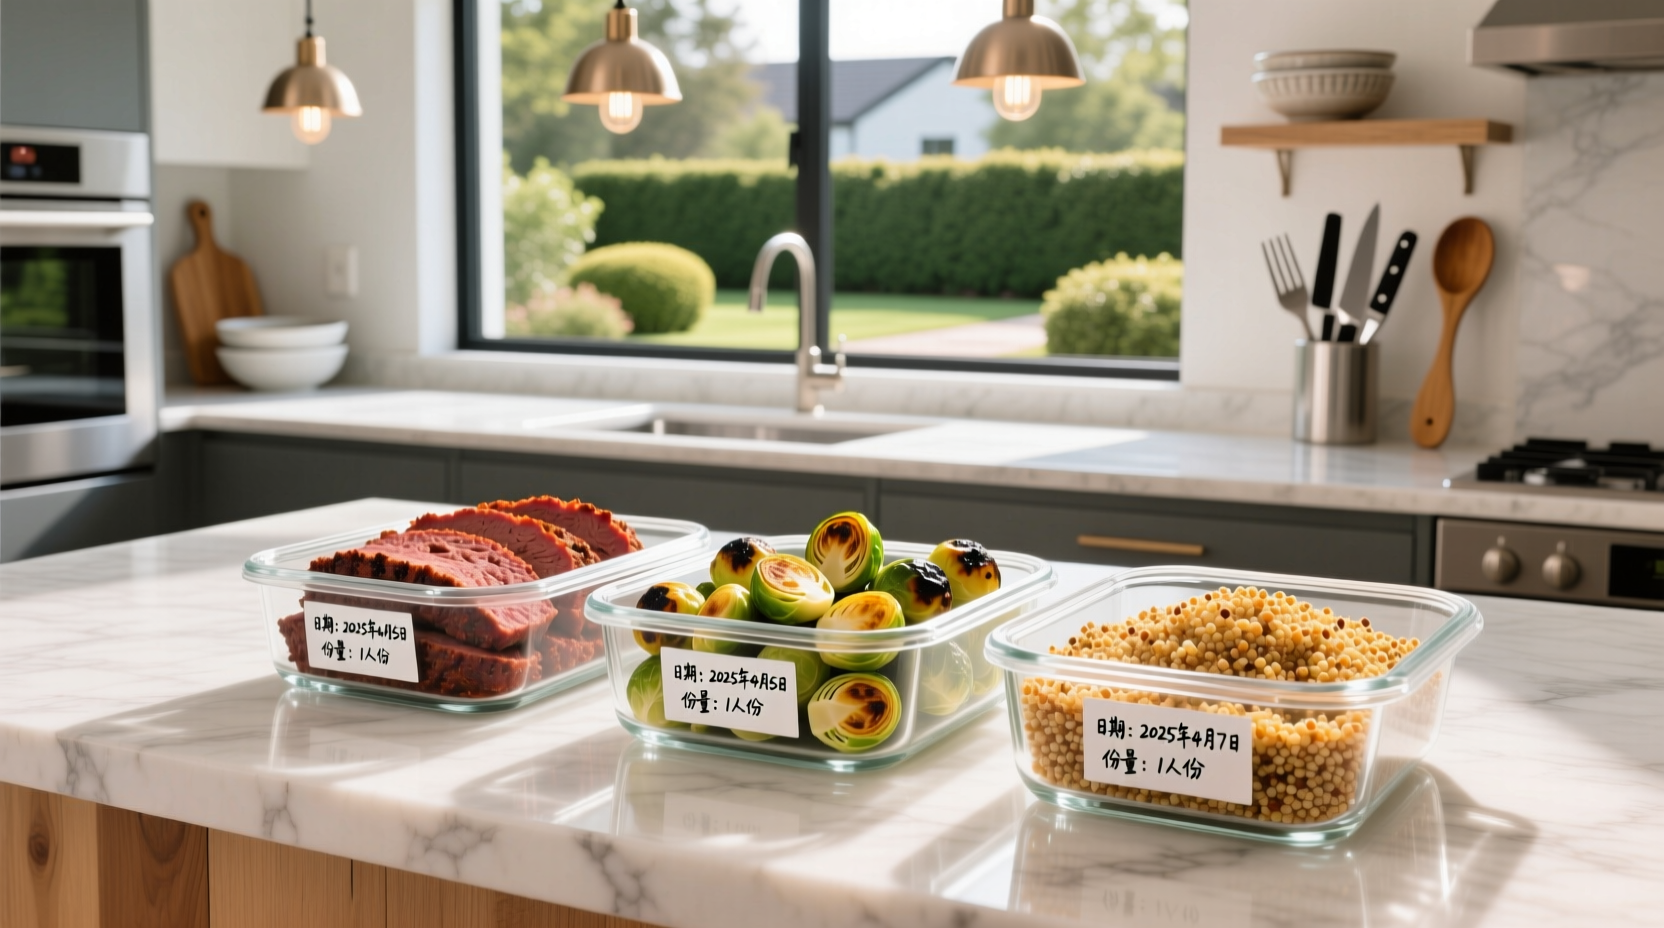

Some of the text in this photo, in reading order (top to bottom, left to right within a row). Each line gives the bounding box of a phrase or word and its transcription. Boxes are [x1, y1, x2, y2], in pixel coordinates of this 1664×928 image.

[674, 662, 787, 692] 日期：2025年4月5日
[680, 689, 764, 717] 份量：1人份
[1097, 715, 1239, 753] 日期：2025年4月7日
[1102, 748, 1206, 780] 份量：1人份
